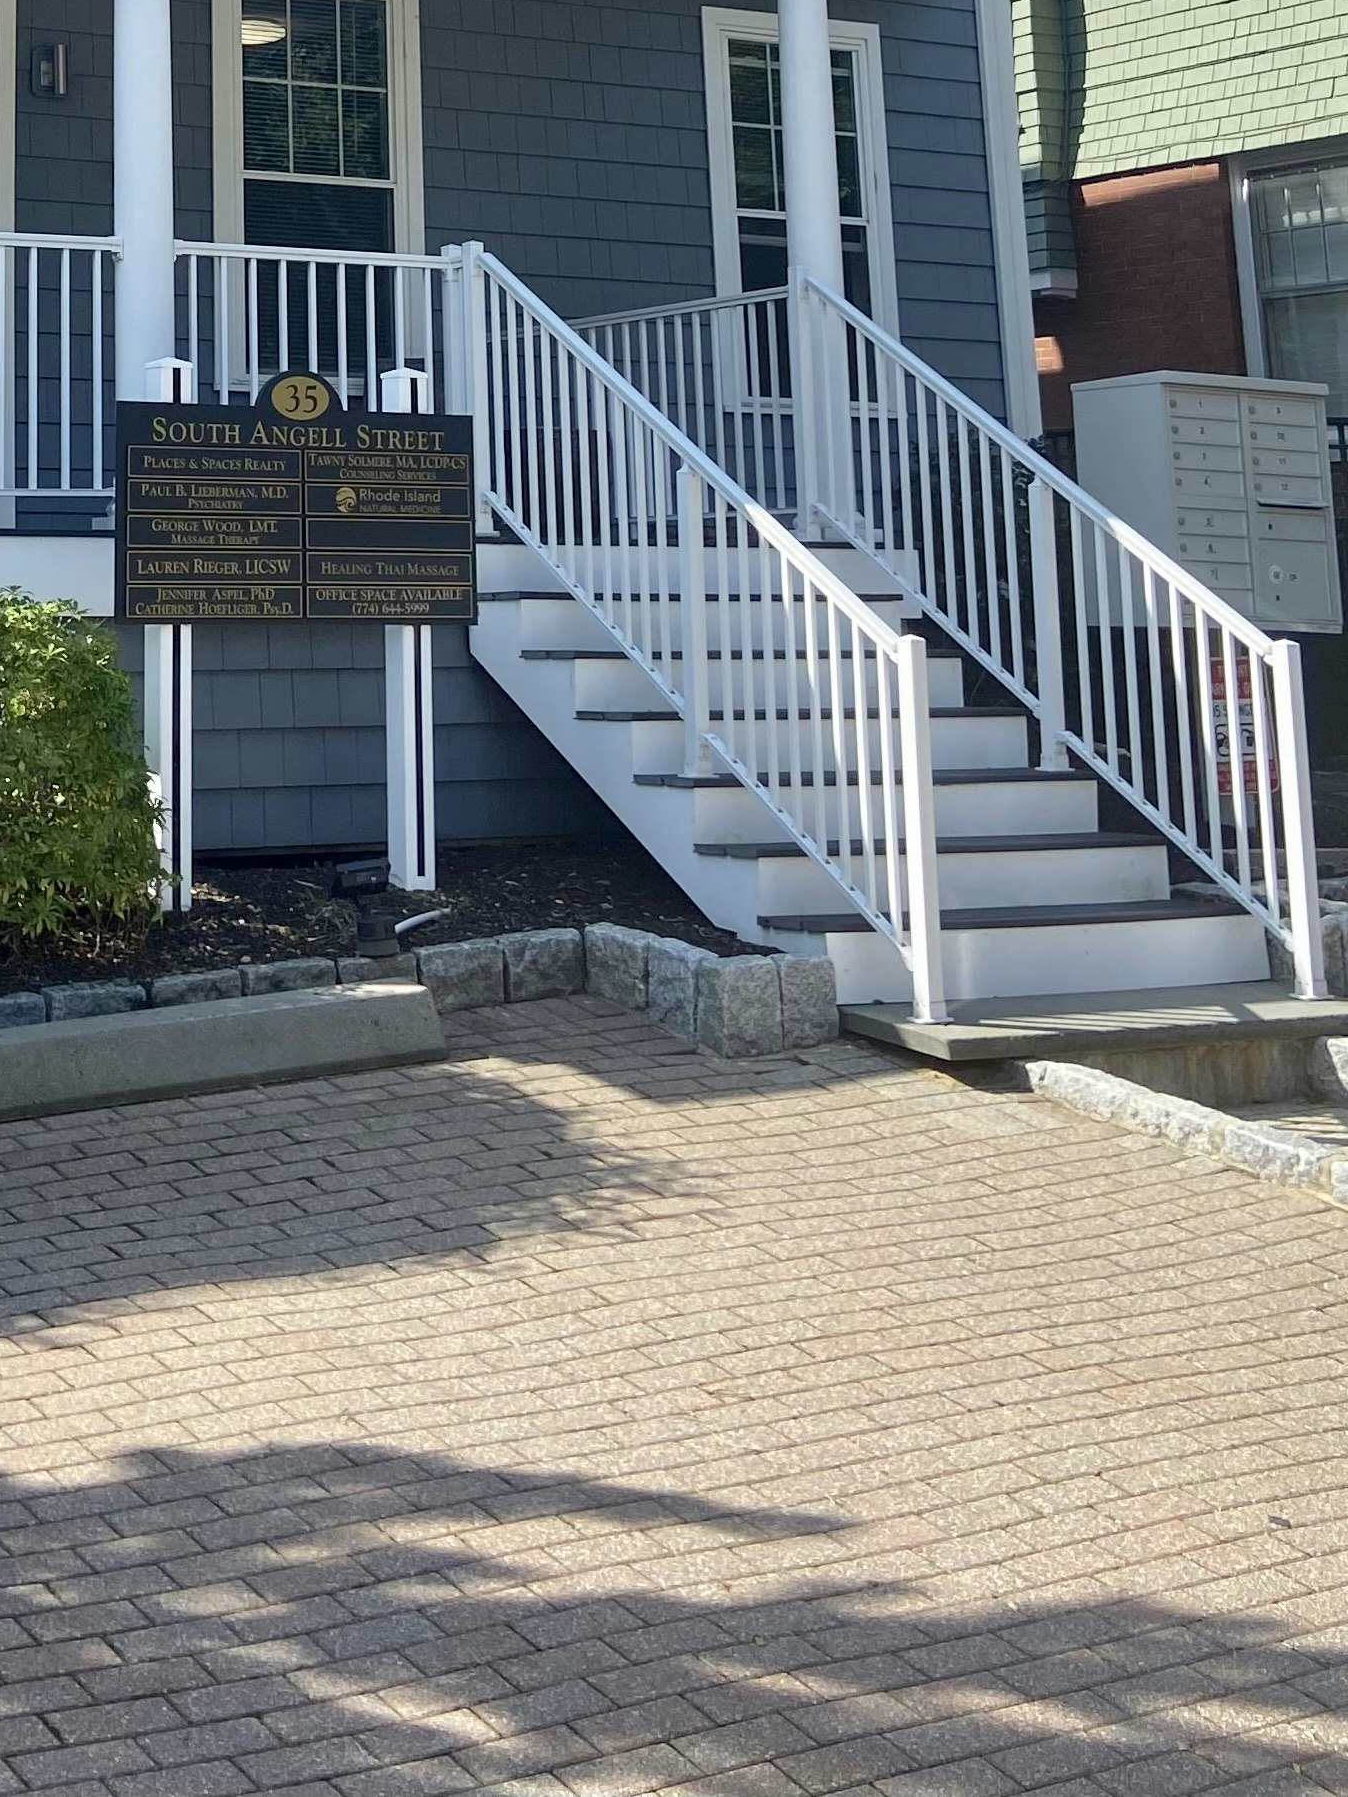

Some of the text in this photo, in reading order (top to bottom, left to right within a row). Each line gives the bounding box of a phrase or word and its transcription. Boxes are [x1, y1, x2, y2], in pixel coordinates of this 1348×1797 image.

[285, 384, 318, 413] 35
[152, 416, 445, 451] SOUTH ANGELL STREET
[189, 458, 199, 469] &
[359, 487, 441, 503] Rhode Island
[358, 504, 441, 514] NATURAL MEDICINE
[245, 558, 292, 575] LICSW
[250, 587, 276, 601] PhD
[315, 588, 463, 602] OFFICE SPACE AVAILABLE
[352, 602, 379, 616] (774)
